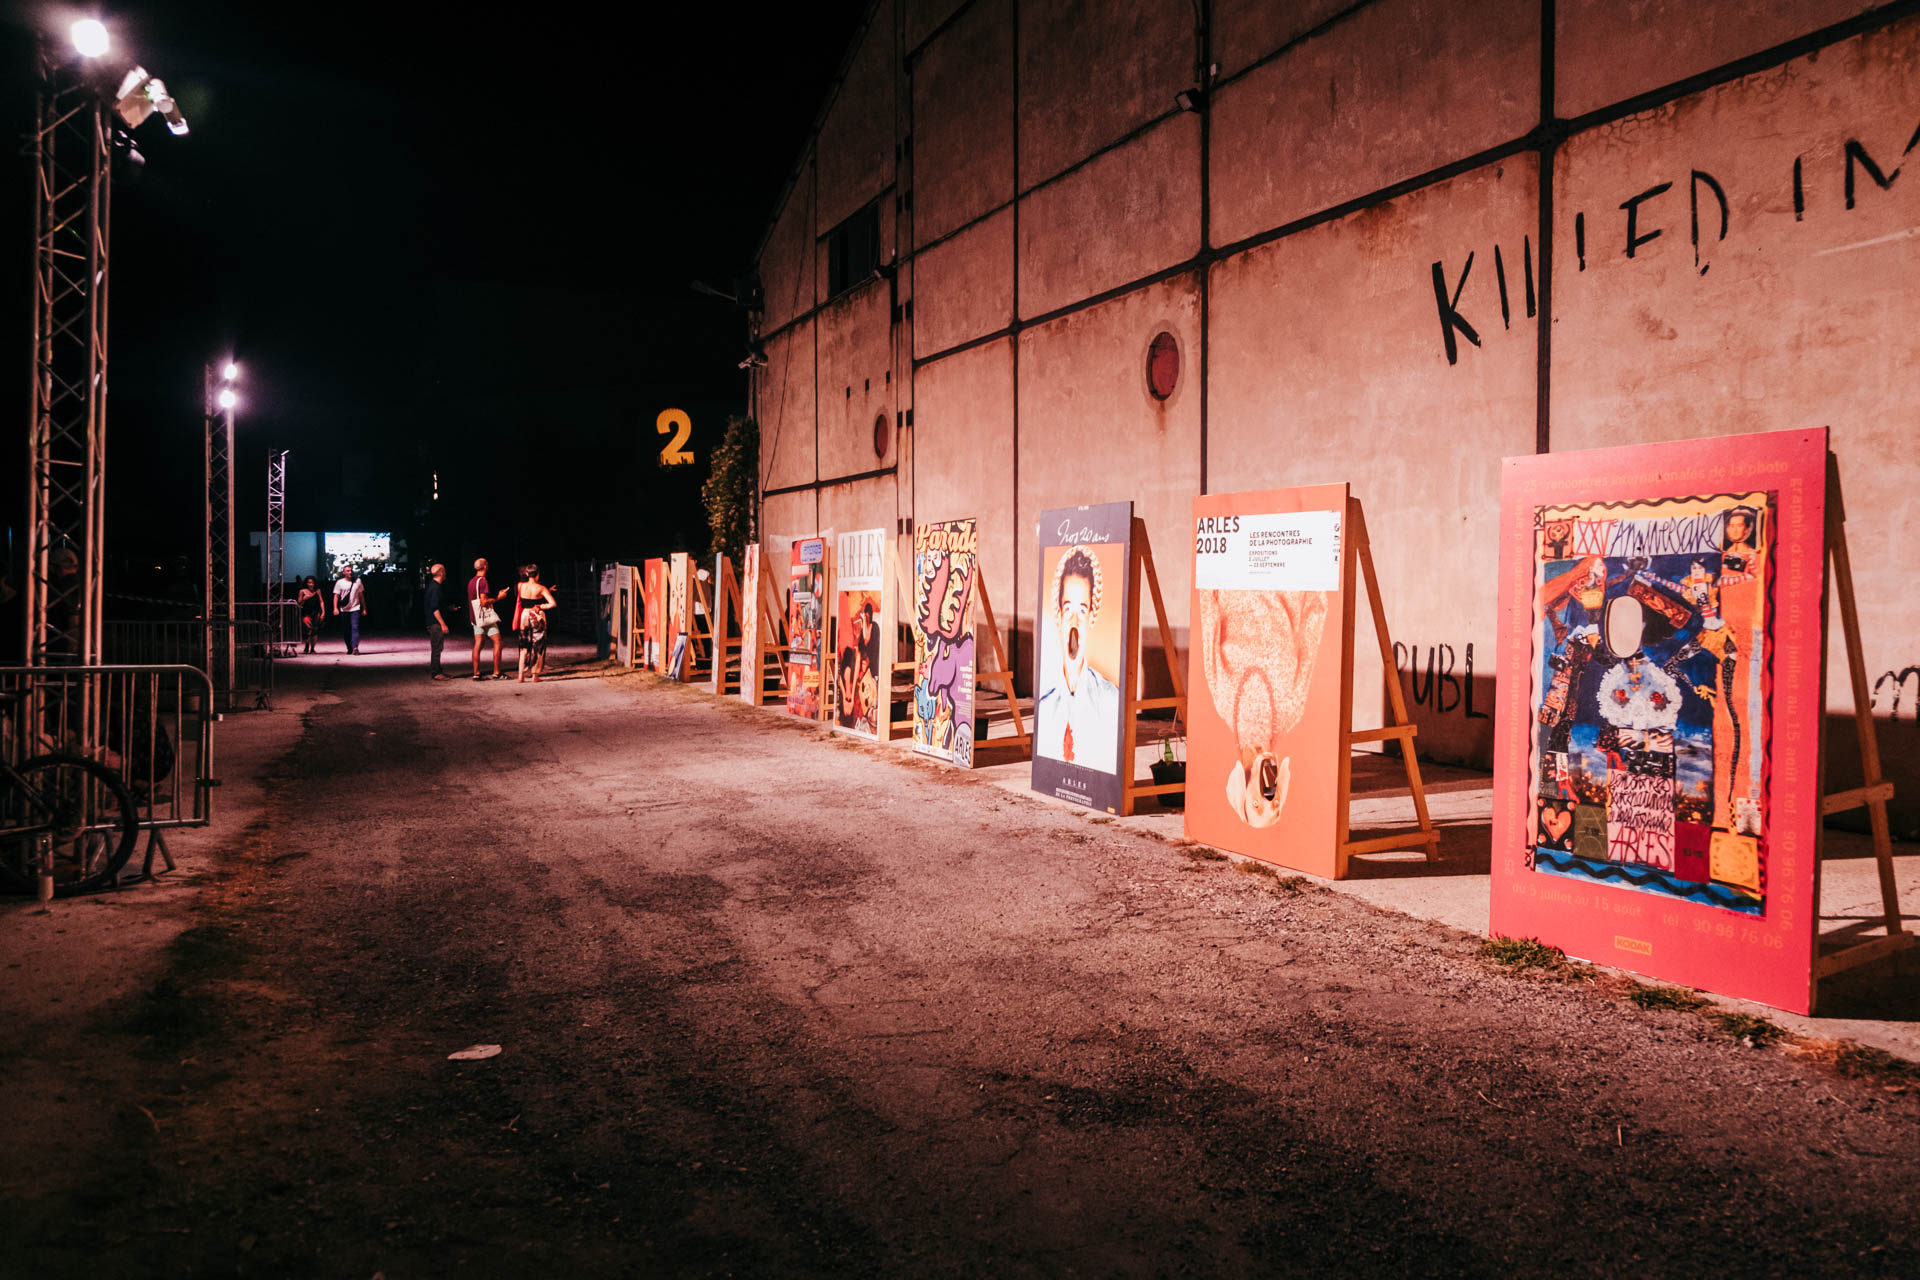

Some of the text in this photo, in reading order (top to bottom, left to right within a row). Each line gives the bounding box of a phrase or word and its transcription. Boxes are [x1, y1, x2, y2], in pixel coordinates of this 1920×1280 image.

[656, 408, 695, 466] 2
[1747, 461, 1788, 478] photo
[1197, 515, 1240, 534] ARLES
[1249, 530, 1301, 539] LES RENCONTRES
[1266, 537, 1313, 546] PHOTOGRAPHIE
[1196, 537, 1228, 554] 2018
[839, 533, 883, 578] ARLES
[1615, 937, 1652, 955] KODAK
